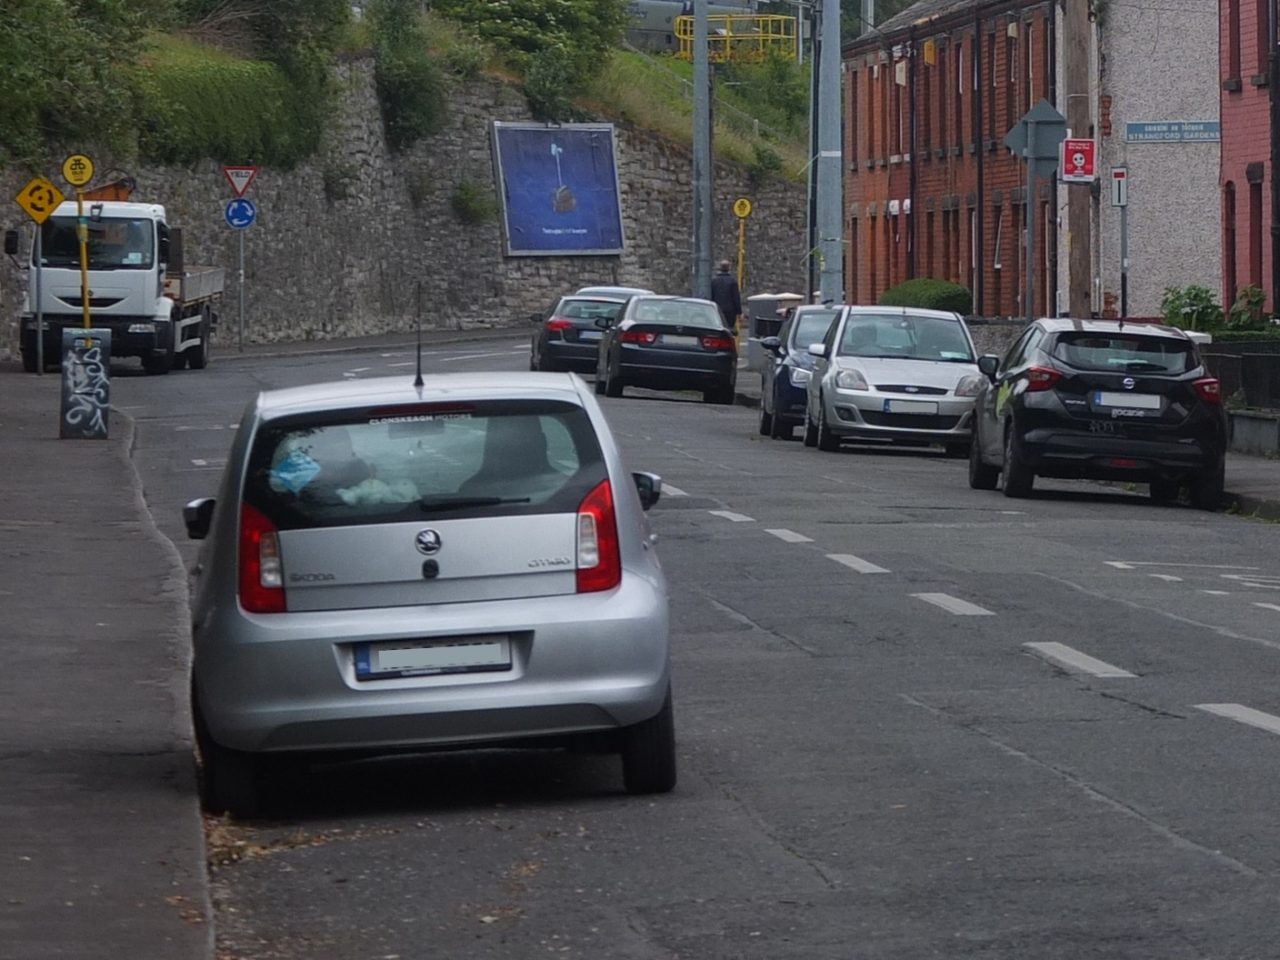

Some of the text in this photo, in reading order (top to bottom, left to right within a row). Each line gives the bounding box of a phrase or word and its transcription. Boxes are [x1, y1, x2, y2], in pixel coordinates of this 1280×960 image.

[1128, 132, 1180, 141] STRANGFORD
[230, 170, 250, 178] YIELD
[369, 413, 472, 426] CLONSKEAGH MOTORS
